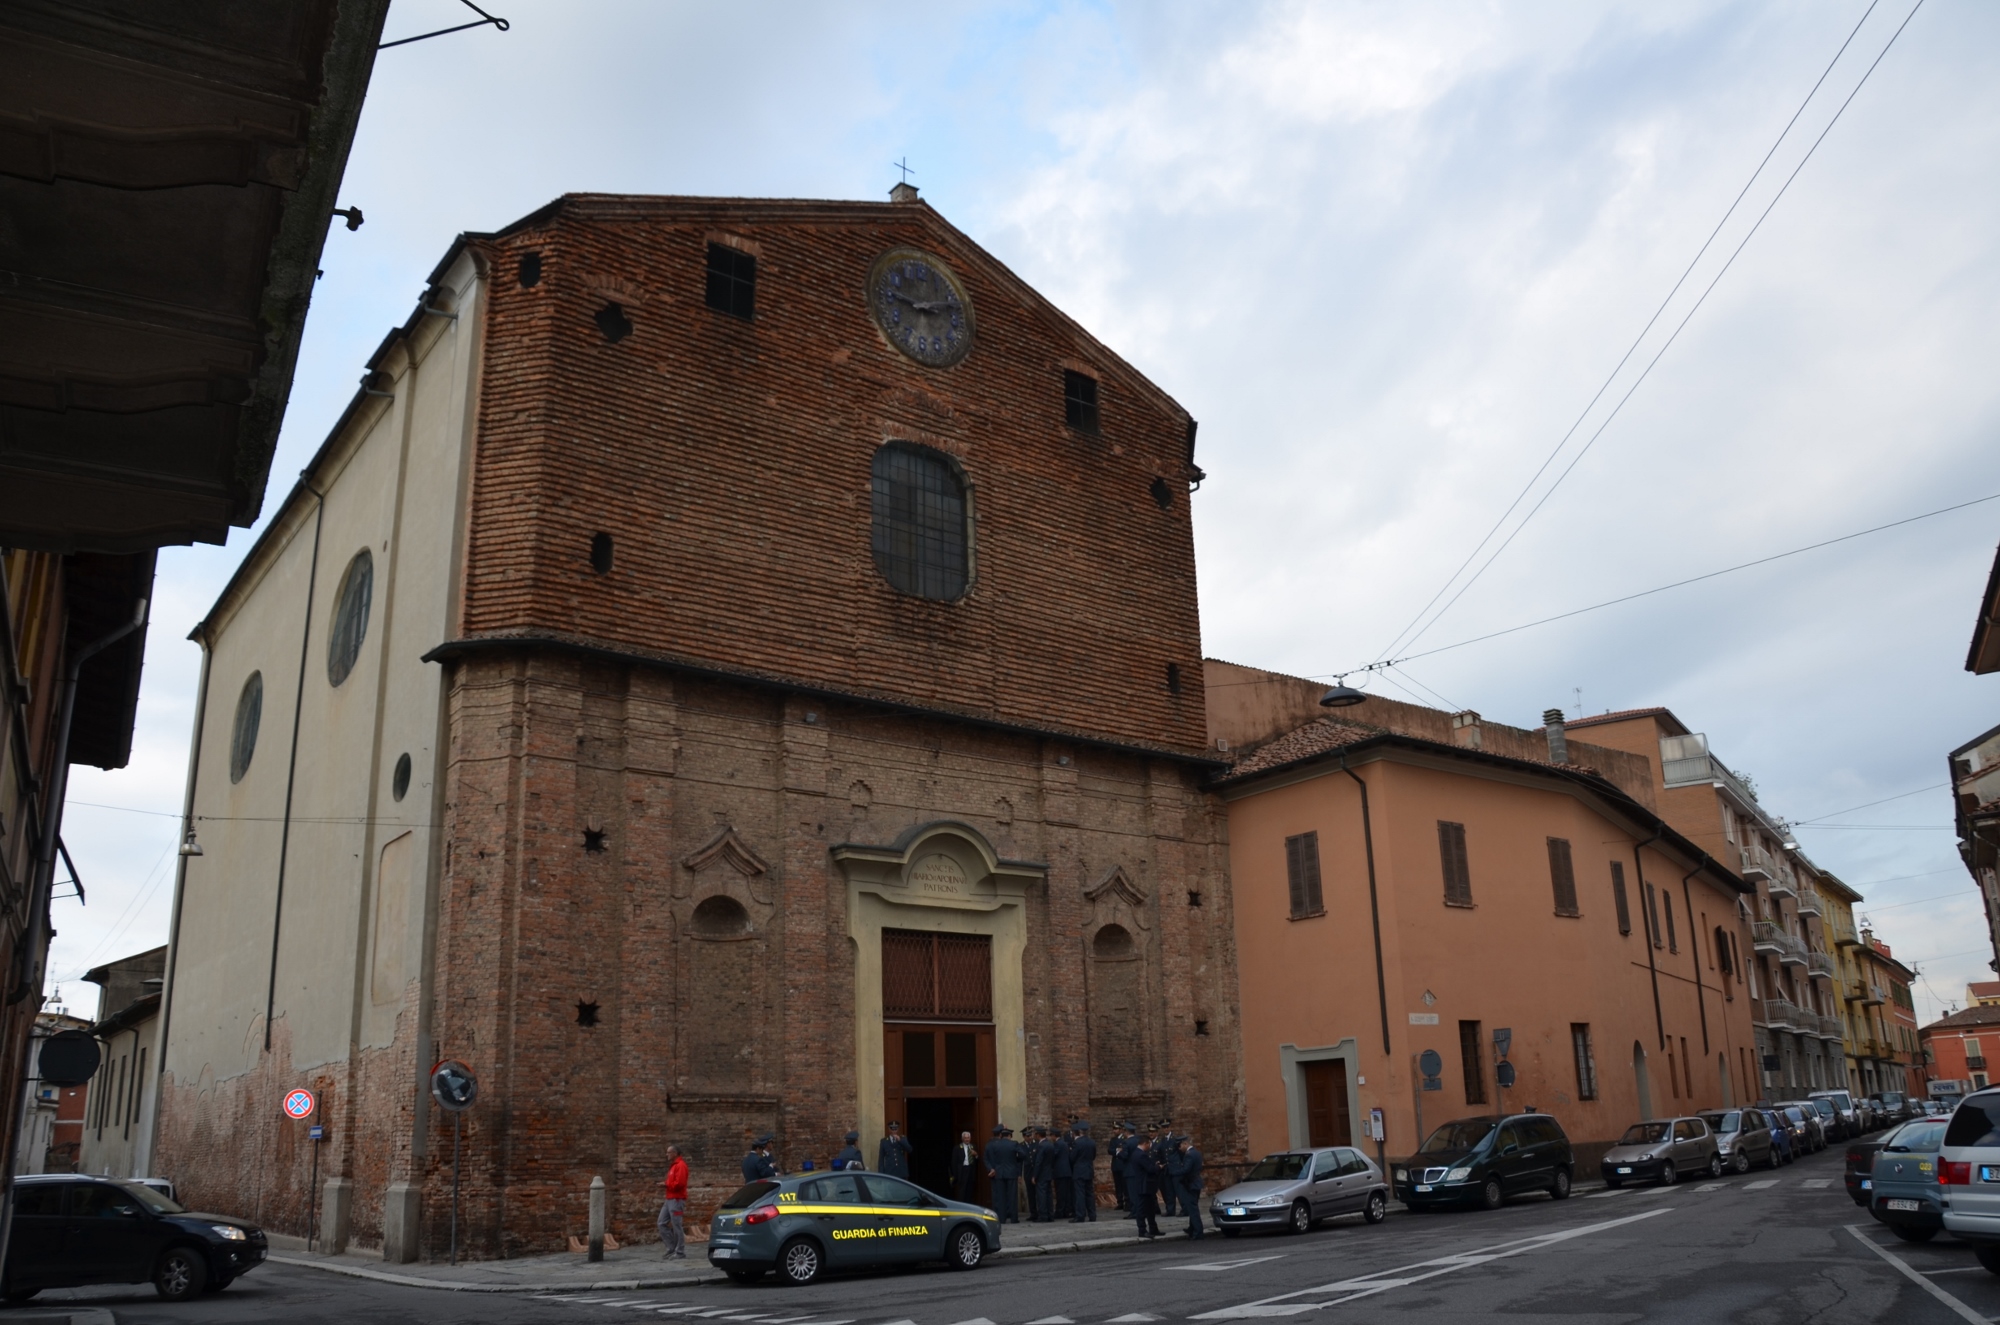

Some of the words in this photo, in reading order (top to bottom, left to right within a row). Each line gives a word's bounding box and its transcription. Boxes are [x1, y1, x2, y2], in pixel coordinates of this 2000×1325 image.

[918, 335, 927, 351] 6
[926, 864, 954, 873] SANCTIS
[924, 883, 958, 894] PATRONIS
[778, 1192, 796, 1202] 117
[832, 1228, 877, 1240] GUARDIA
[877, 1227, 887, 1237] di
[888, 1225, 928, 1237] FINANZA
